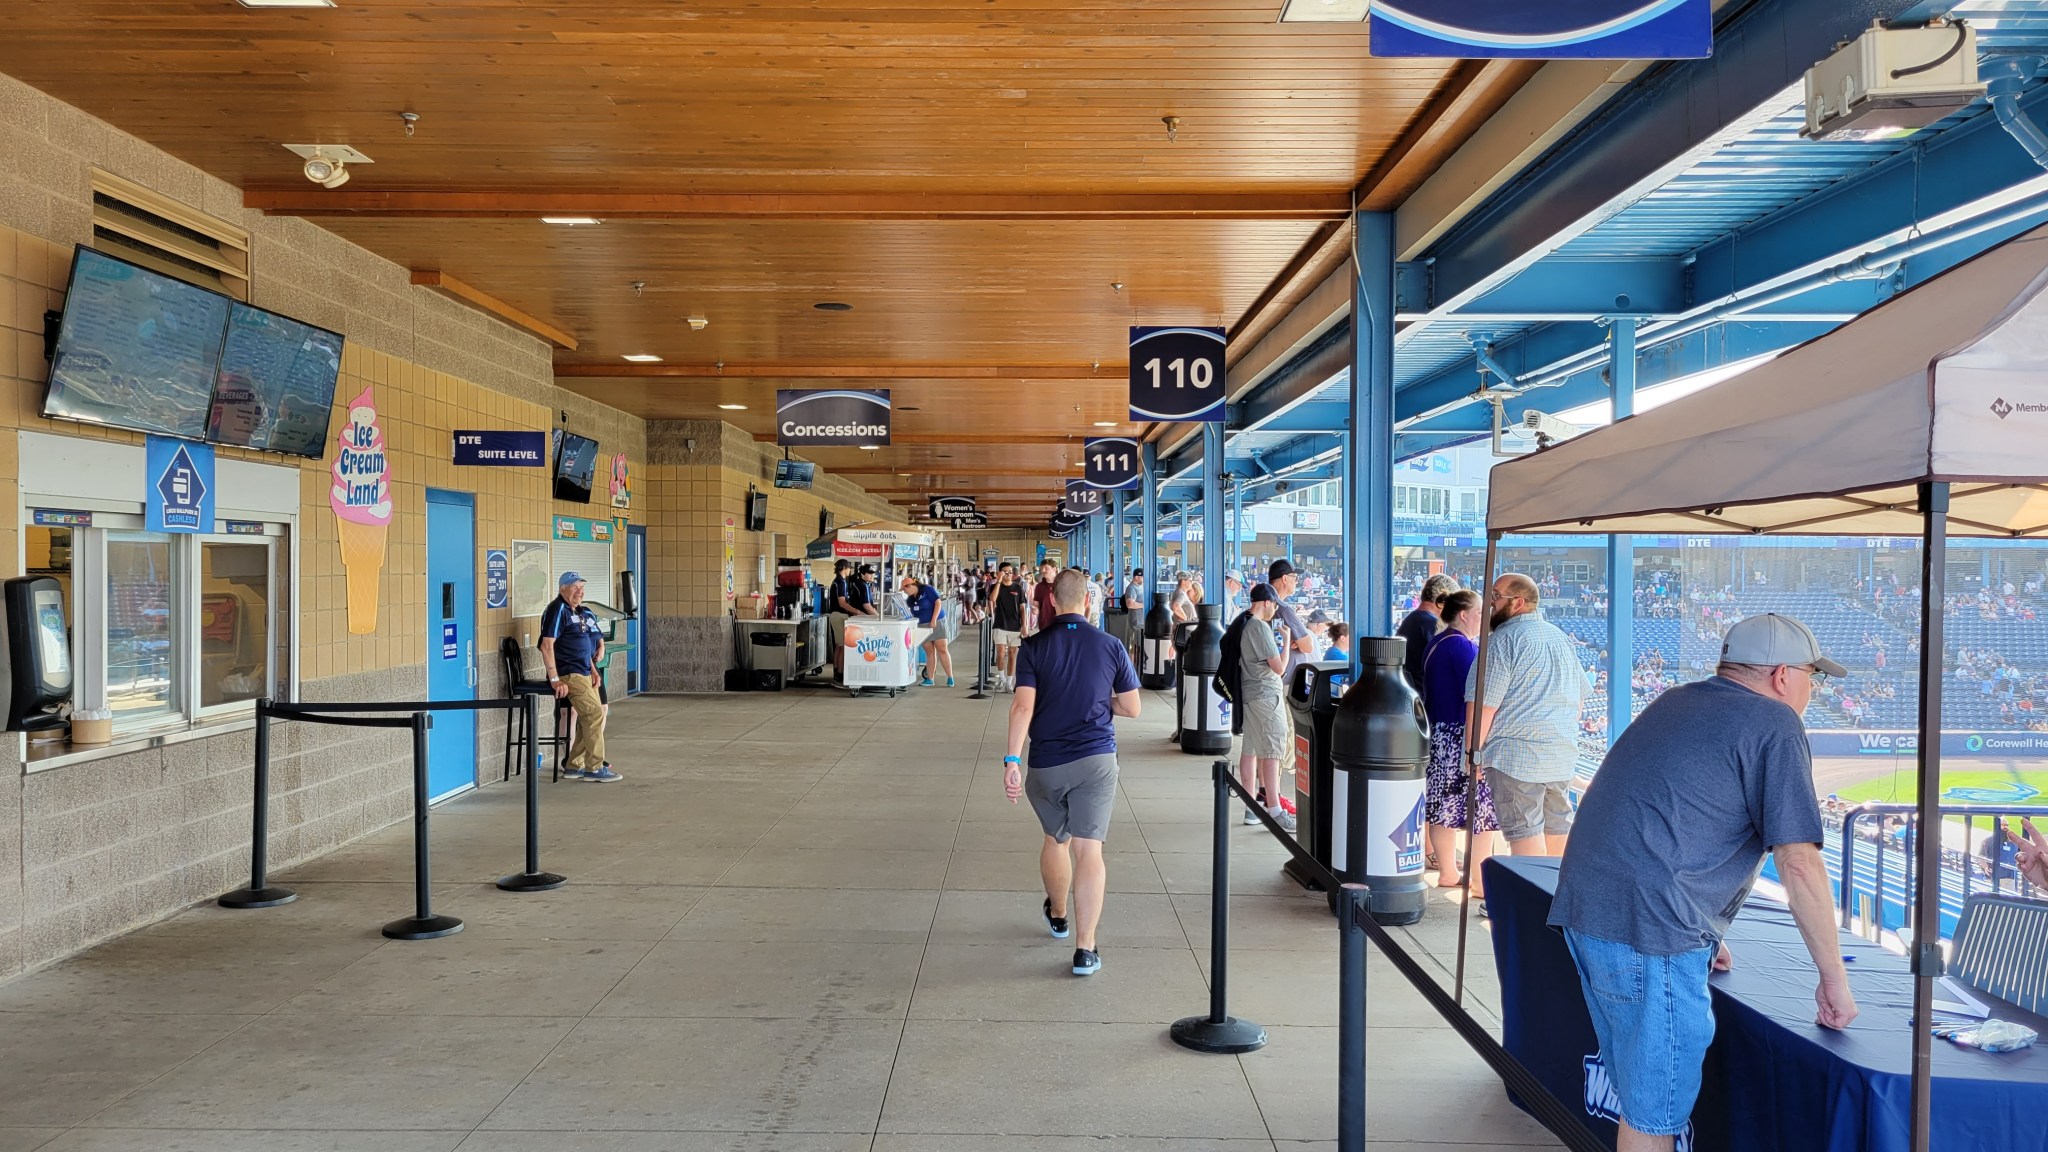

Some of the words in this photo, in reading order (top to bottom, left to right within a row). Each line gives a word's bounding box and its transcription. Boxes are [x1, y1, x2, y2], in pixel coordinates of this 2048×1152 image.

[1143, 357, 1213, 389] 110
[2016, 403, 2048, 412] Memb
[353, 421, 373, 448] Ice
[781, 420, 888, 438] Concessions
[459, 435, 482, 445] DTE
[340, 448, 384, 475] Cream
[478, 450, 506, 459] SUITE
[508, 450, 538, 460] LEVEL
[1092, 453, 1129, 471] 111
[346, 479, 379, 505] Land
[1070, 490, 1097, 503] 112
[167, 514, 196, 525] CASHLESS
[1186, 530, 1204, 541] DTE
[1444, 537, 1457, 547] DTE
[1687, 538, 1711, 547] DTE
[1866, 538, 1890, 548] DTE
[499, 579, 507, 590] 301
[857, 636, 893, 655] dippin'
[1859, 733, 1892, 748] We
[1895, 735, 1918, 748] ca
[1985, 738, 2032, 748] Corewell
[2034, 737, 2048, 748] He
[1406, 831, 1422, 847] LM
[1399, 854, 1423, 867] BALL
